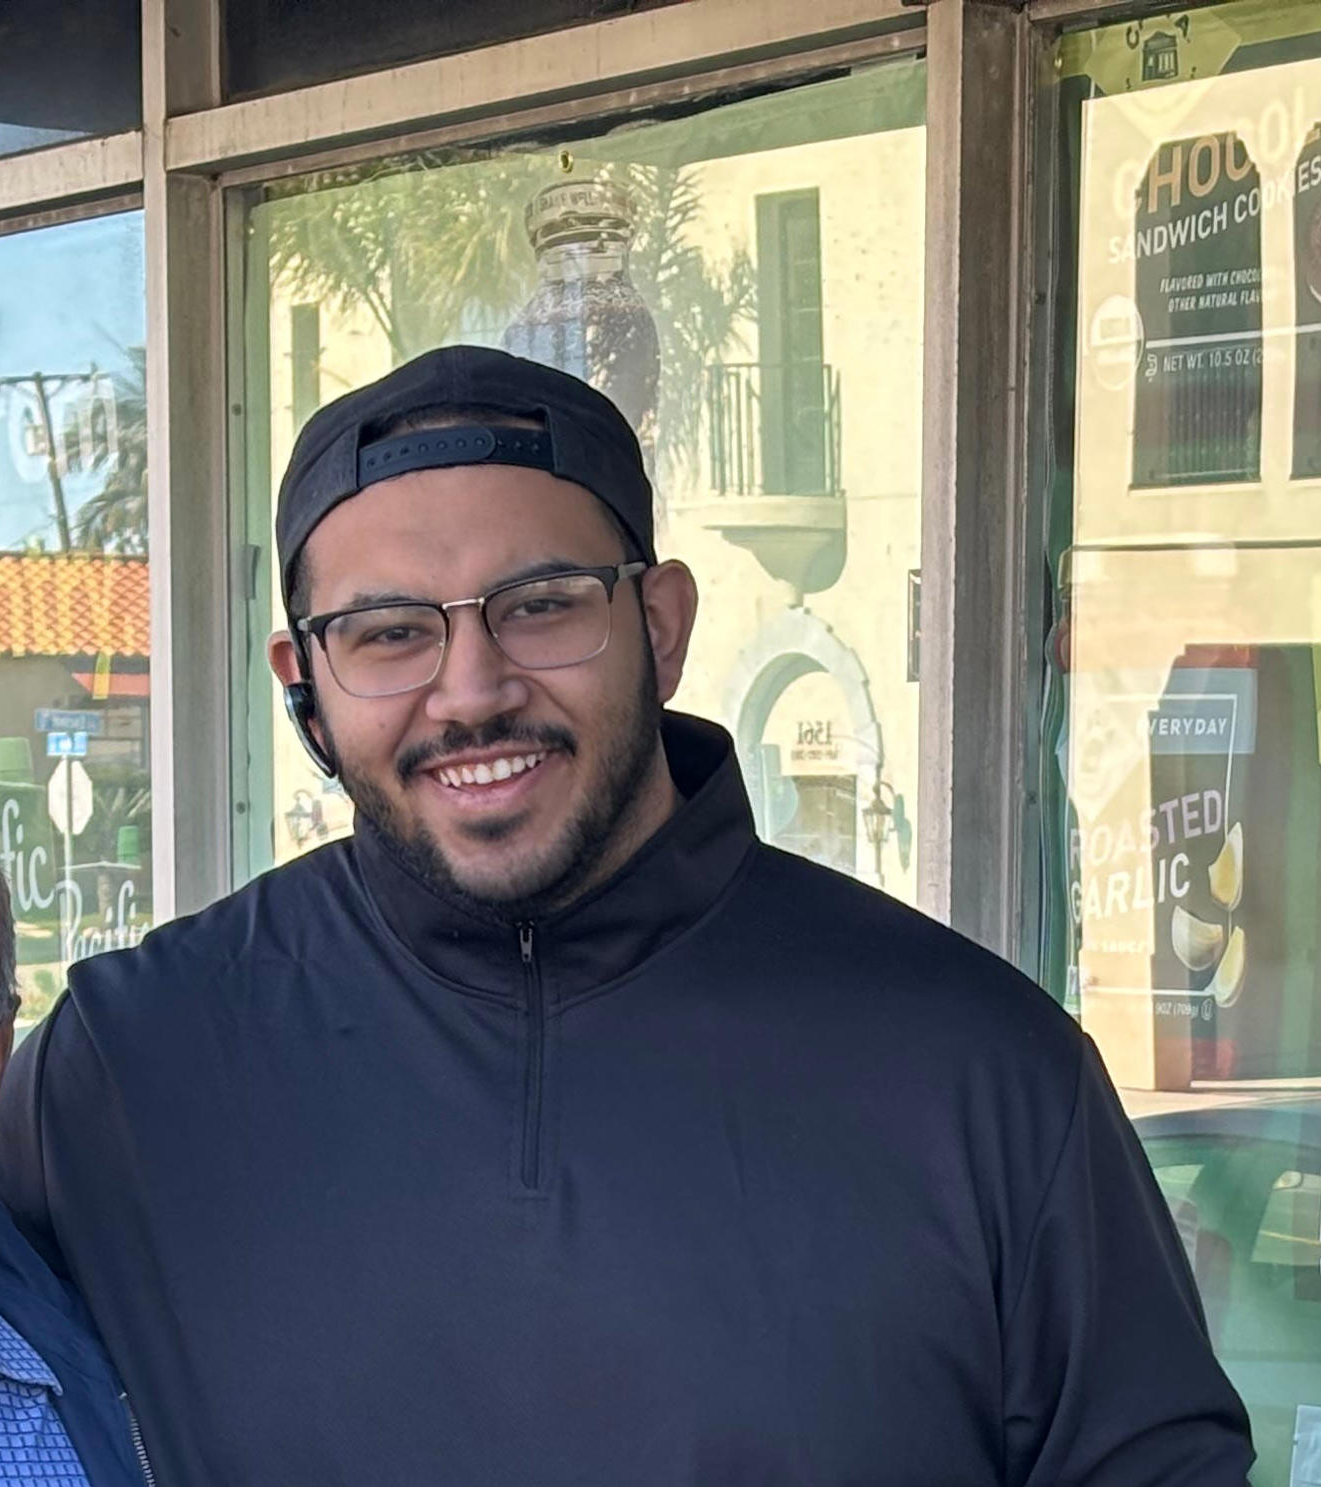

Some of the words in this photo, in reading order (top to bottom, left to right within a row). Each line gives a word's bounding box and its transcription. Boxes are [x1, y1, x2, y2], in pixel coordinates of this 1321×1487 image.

[1108, 202, 1229, 265] SANDWICH
[1163, 354, 1186, 373] NET
[1070, 852, 1191, 924] GARLIC
